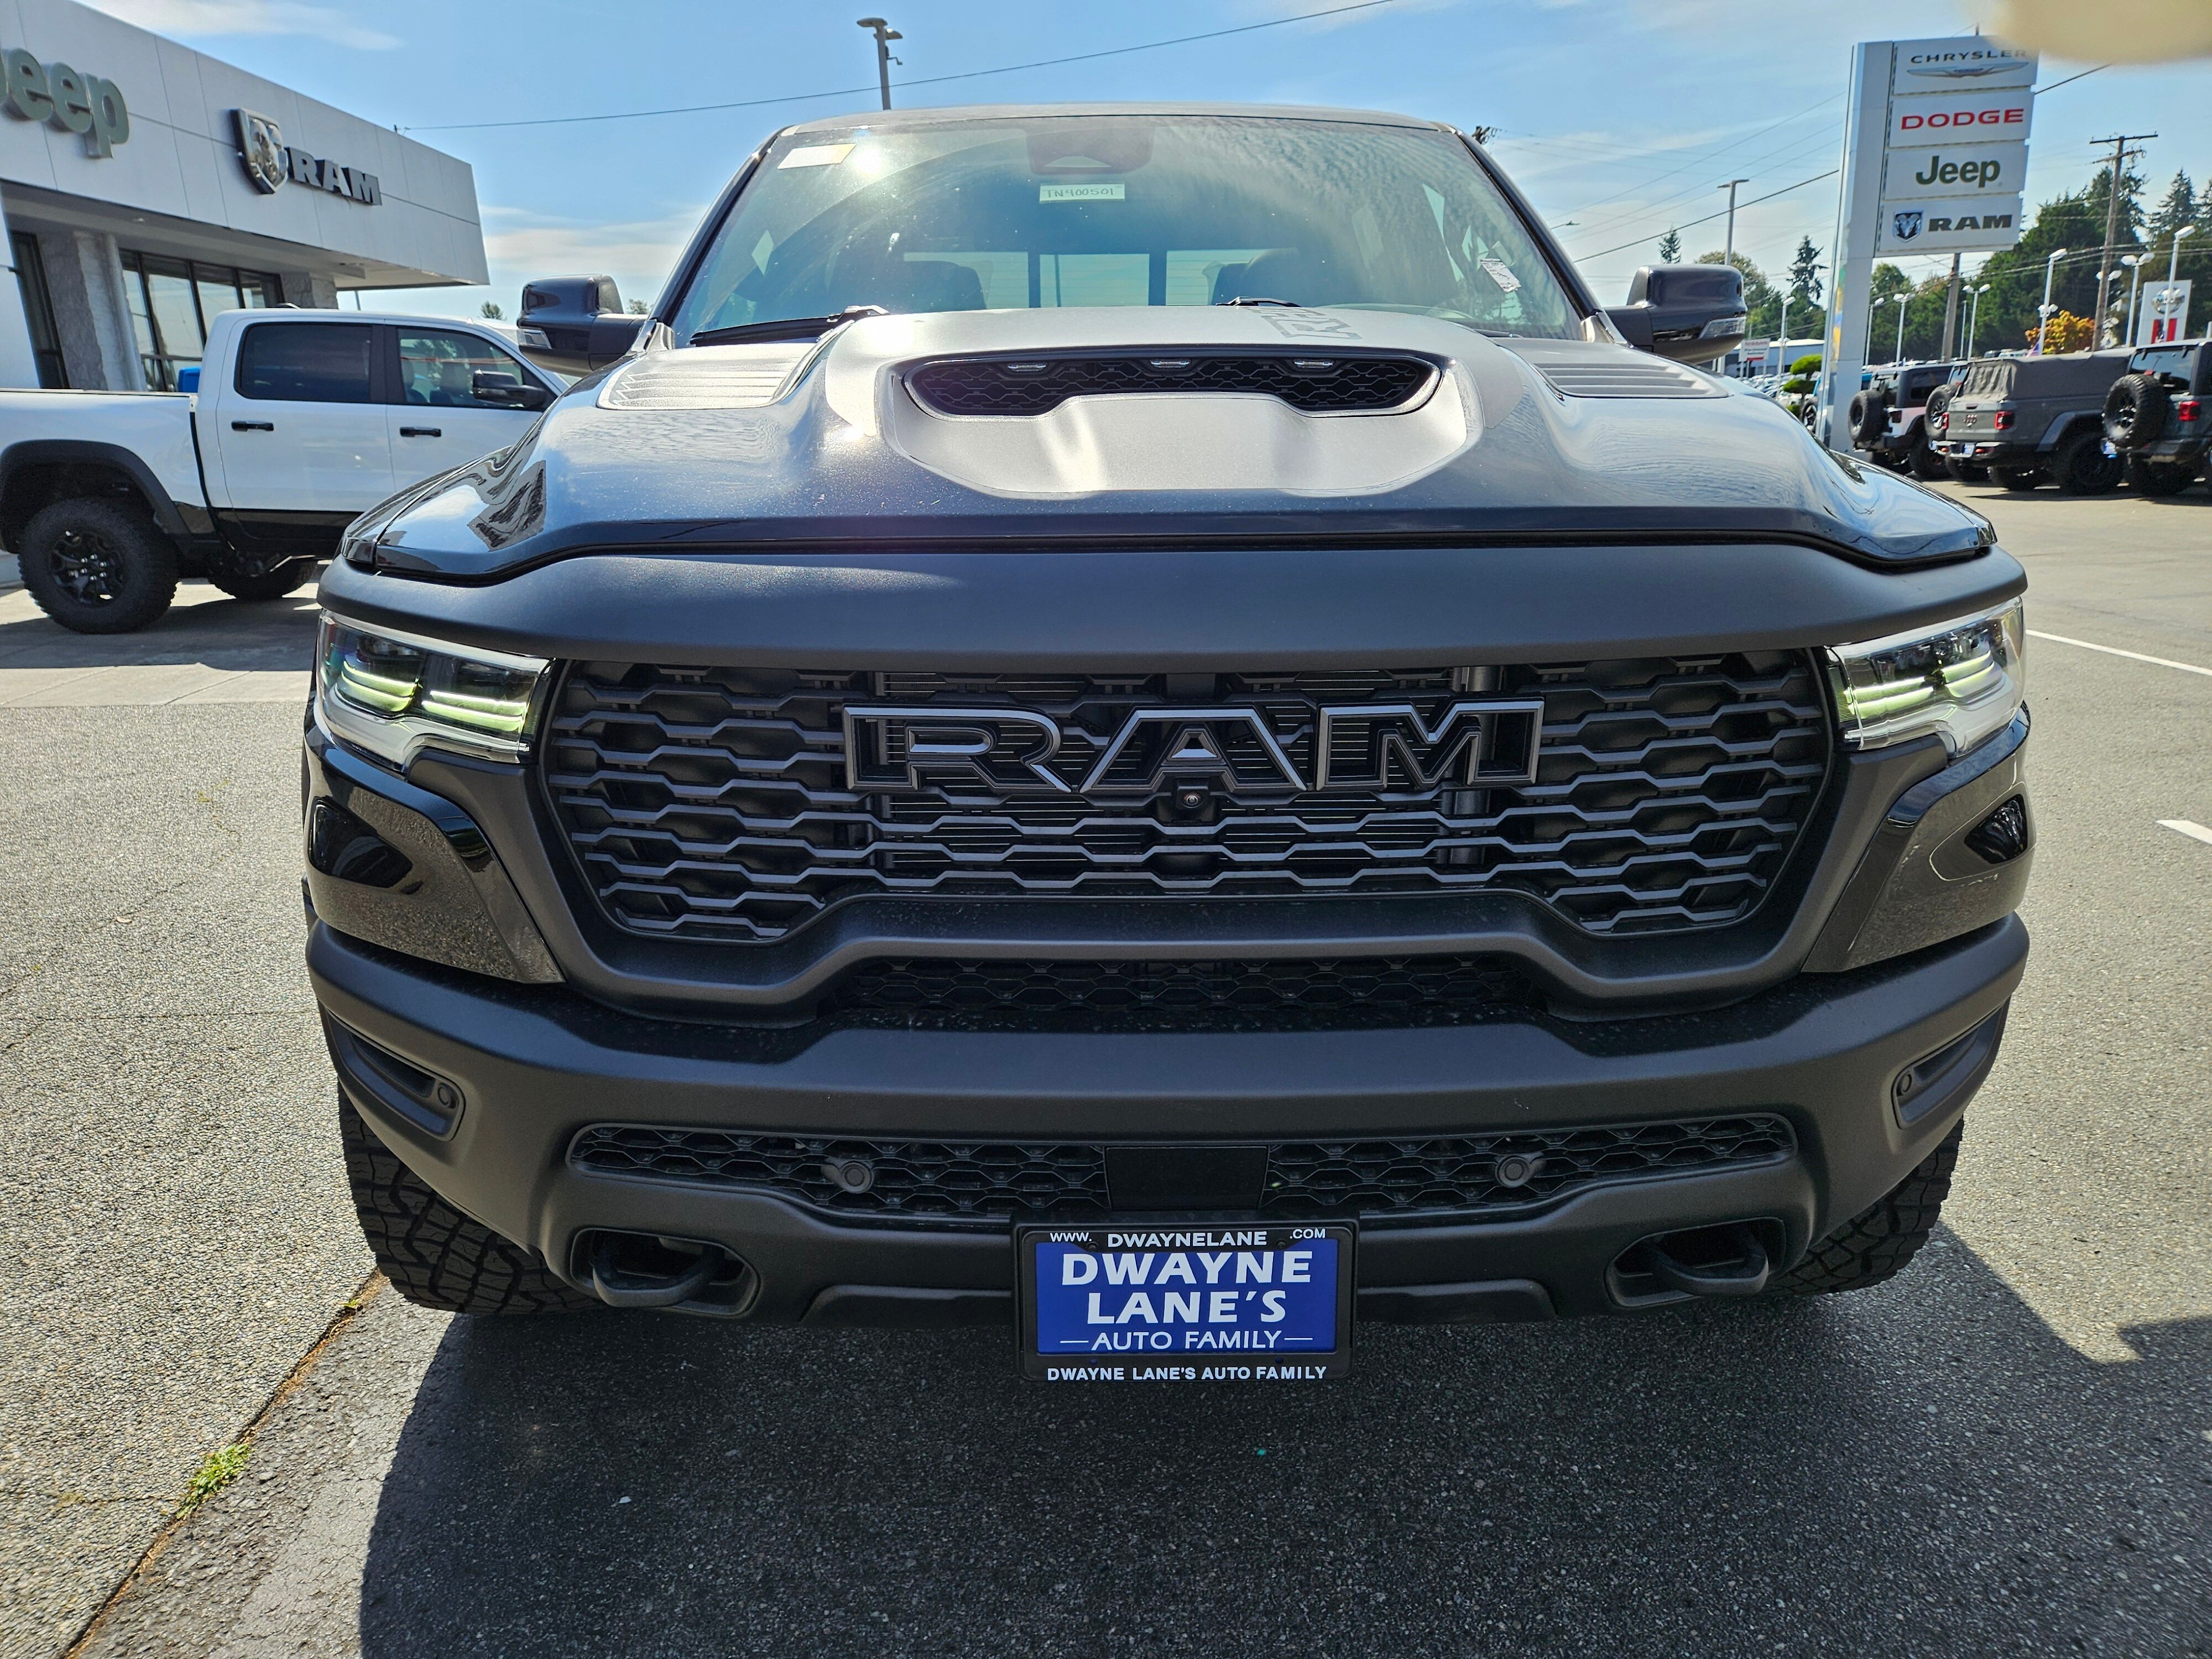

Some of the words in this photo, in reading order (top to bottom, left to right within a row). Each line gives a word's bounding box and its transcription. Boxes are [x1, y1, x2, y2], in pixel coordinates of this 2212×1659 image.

[1911, 50, 2028, 64] CHRYSLER
[0, 46, 129, 158] eep
[1901, 108, 2024, 130] DODGE
[285, 147, 382, 206] RAM
[1916, 155, 2001, 188] Jeep
[1042, 187, 1113, 198] TN400501
[1928, 215, 2012, 232] RAM
[843, 698, 1545, 793] RAM
[1108, 1232, 1267, 1247] DWAYNELANE
[1290, 1228, 1326, 1239] .COM
[1062, 1251, 1313, 1285] DWAYNE
[1087, 1290, 1286, 1324] LANE'S
[1091, 1331, 1172, 1350] AUTO
[1185, 1331, 1282, 1349] FAMILY
[1047, 1368, 1124, 1381] DWAYNE
[1133, 1367, 1196, 1380] LANE'S
[1201, 1367, 1251, 1380] AUTO
[1256, 1366, 1327, 1379] FAMILY
